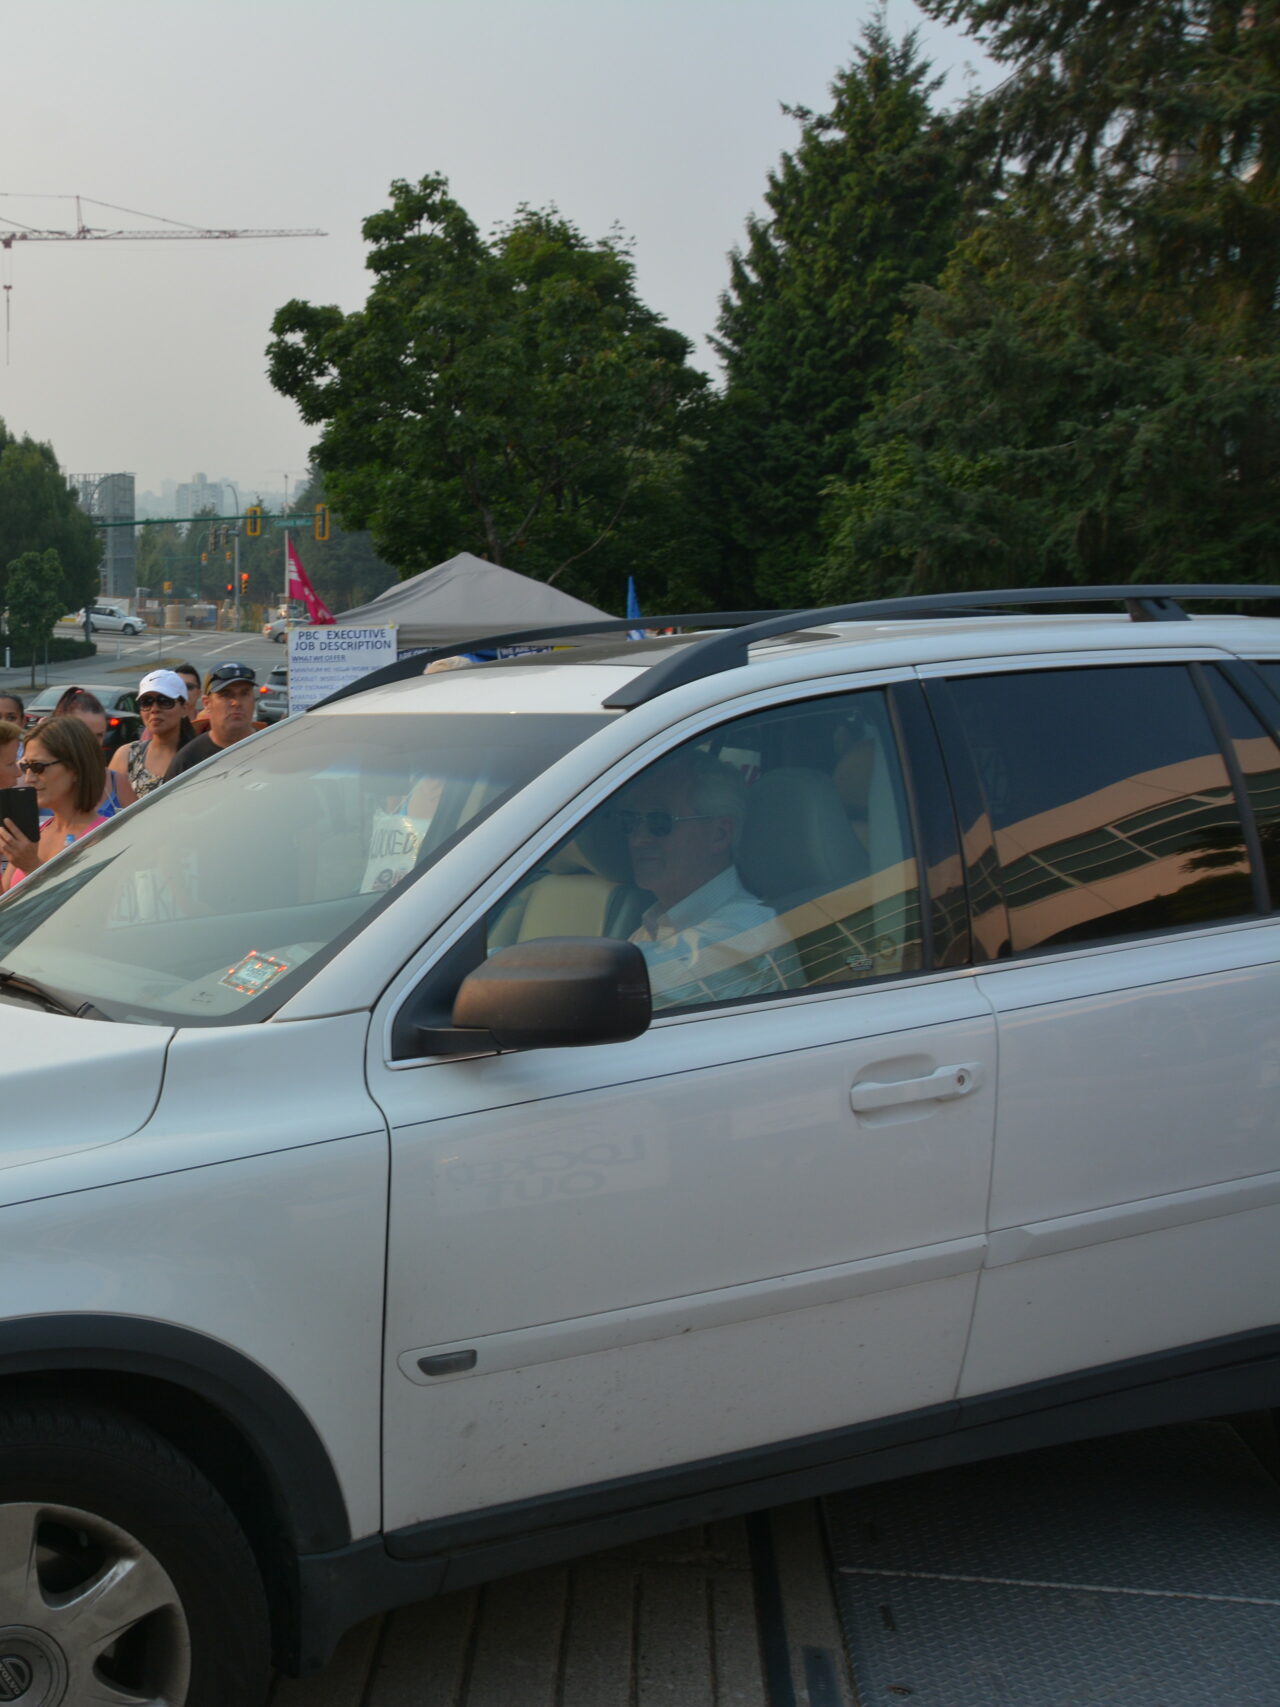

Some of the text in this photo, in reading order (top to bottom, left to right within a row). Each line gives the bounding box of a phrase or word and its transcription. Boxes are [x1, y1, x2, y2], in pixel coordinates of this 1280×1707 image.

[298, 629, 387, 640] PBC EXECUTIVE
[295, 640, 392, 651] JOB DESCRIPTION
[325, 654, 346, 662] OFFER
